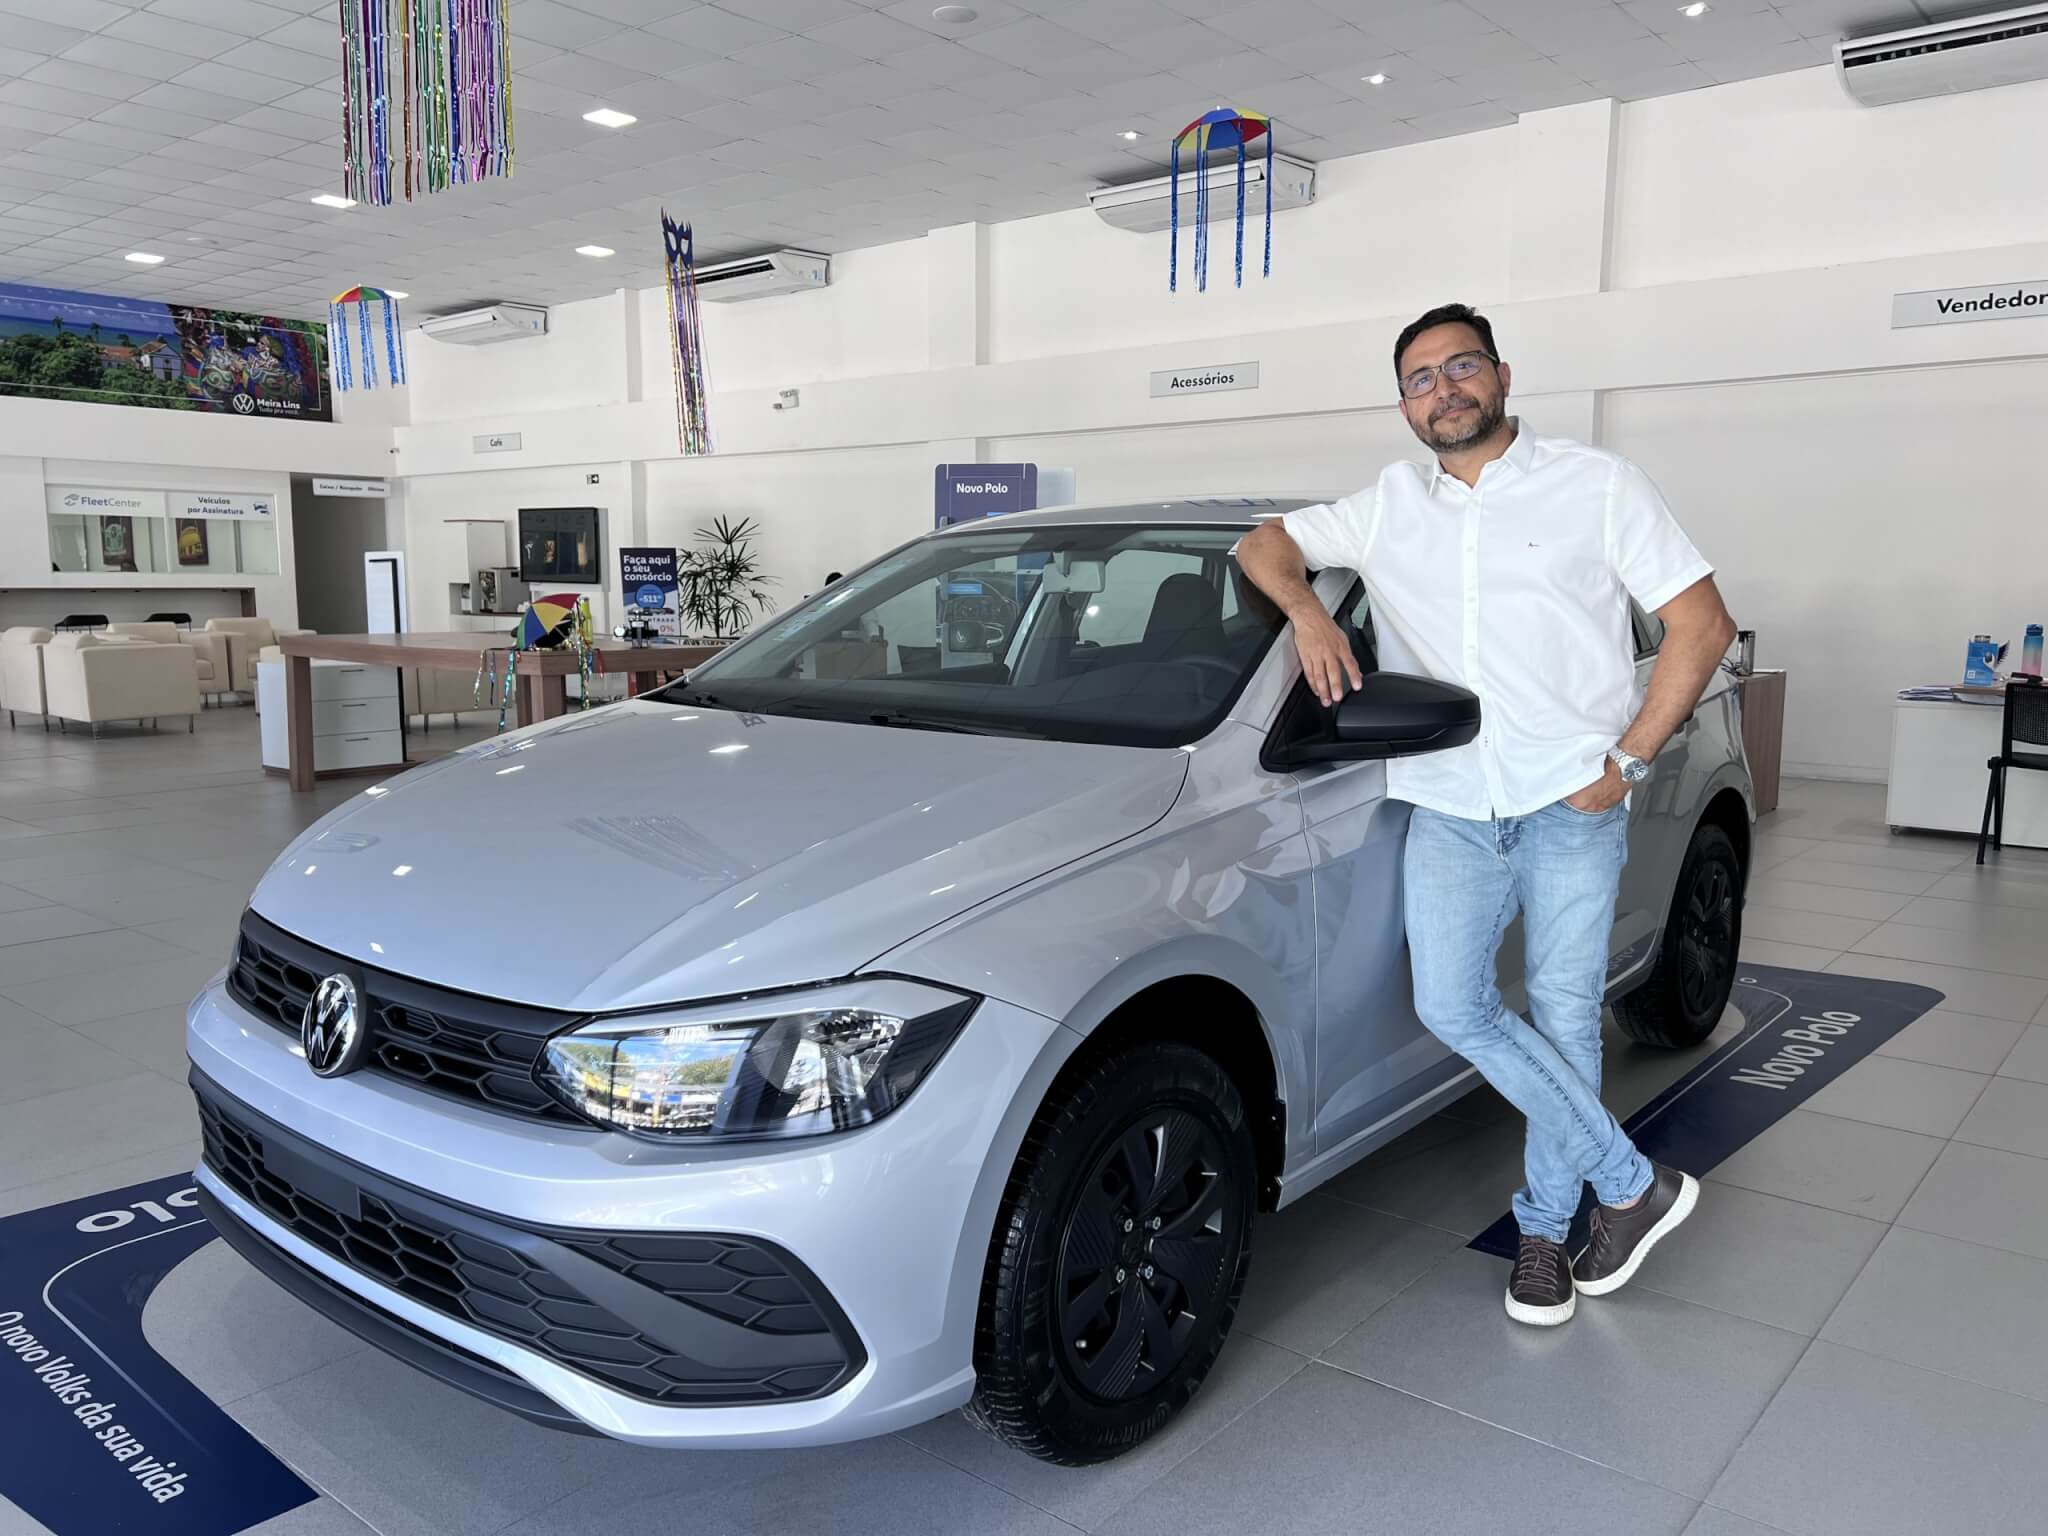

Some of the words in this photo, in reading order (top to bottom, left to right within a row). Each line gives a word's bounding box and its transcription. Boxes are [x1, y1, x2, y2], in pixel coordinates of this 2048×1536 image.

[1170, 371, 1235, 389] Acessórios
[257, 398, 281, 409] Meira
[282, 401, 301, 410] Lins
[956, 483, 983, 493] Novo
[985, 483, 1008, 493] Polo
[80, 496, 142, 509] FleetCenter
[198, 496, 231, 505] Veículos
[187, 507, 201, 515] por
[202, 506, 244, 515] Assinatura
[623, 555, 646, 565] Faça
[648, 555, 671, 566] aqui
[624, 572, 672, 581] consórcio
[632, 565, 650, 573] seu
[1729, 1044, 1825, 1090] Novo
[1781, 1011, 1862, 1045] Polo
[0, 1311, 24, 1334] O
[2, 1325, 50, 1362] novo
[34, 1355, 92, 1405] Volks
[73, 1402, 117, 1429] da
[95, 1424, 145, 1462] sua
[128, 1455, 189, 1504] vida
